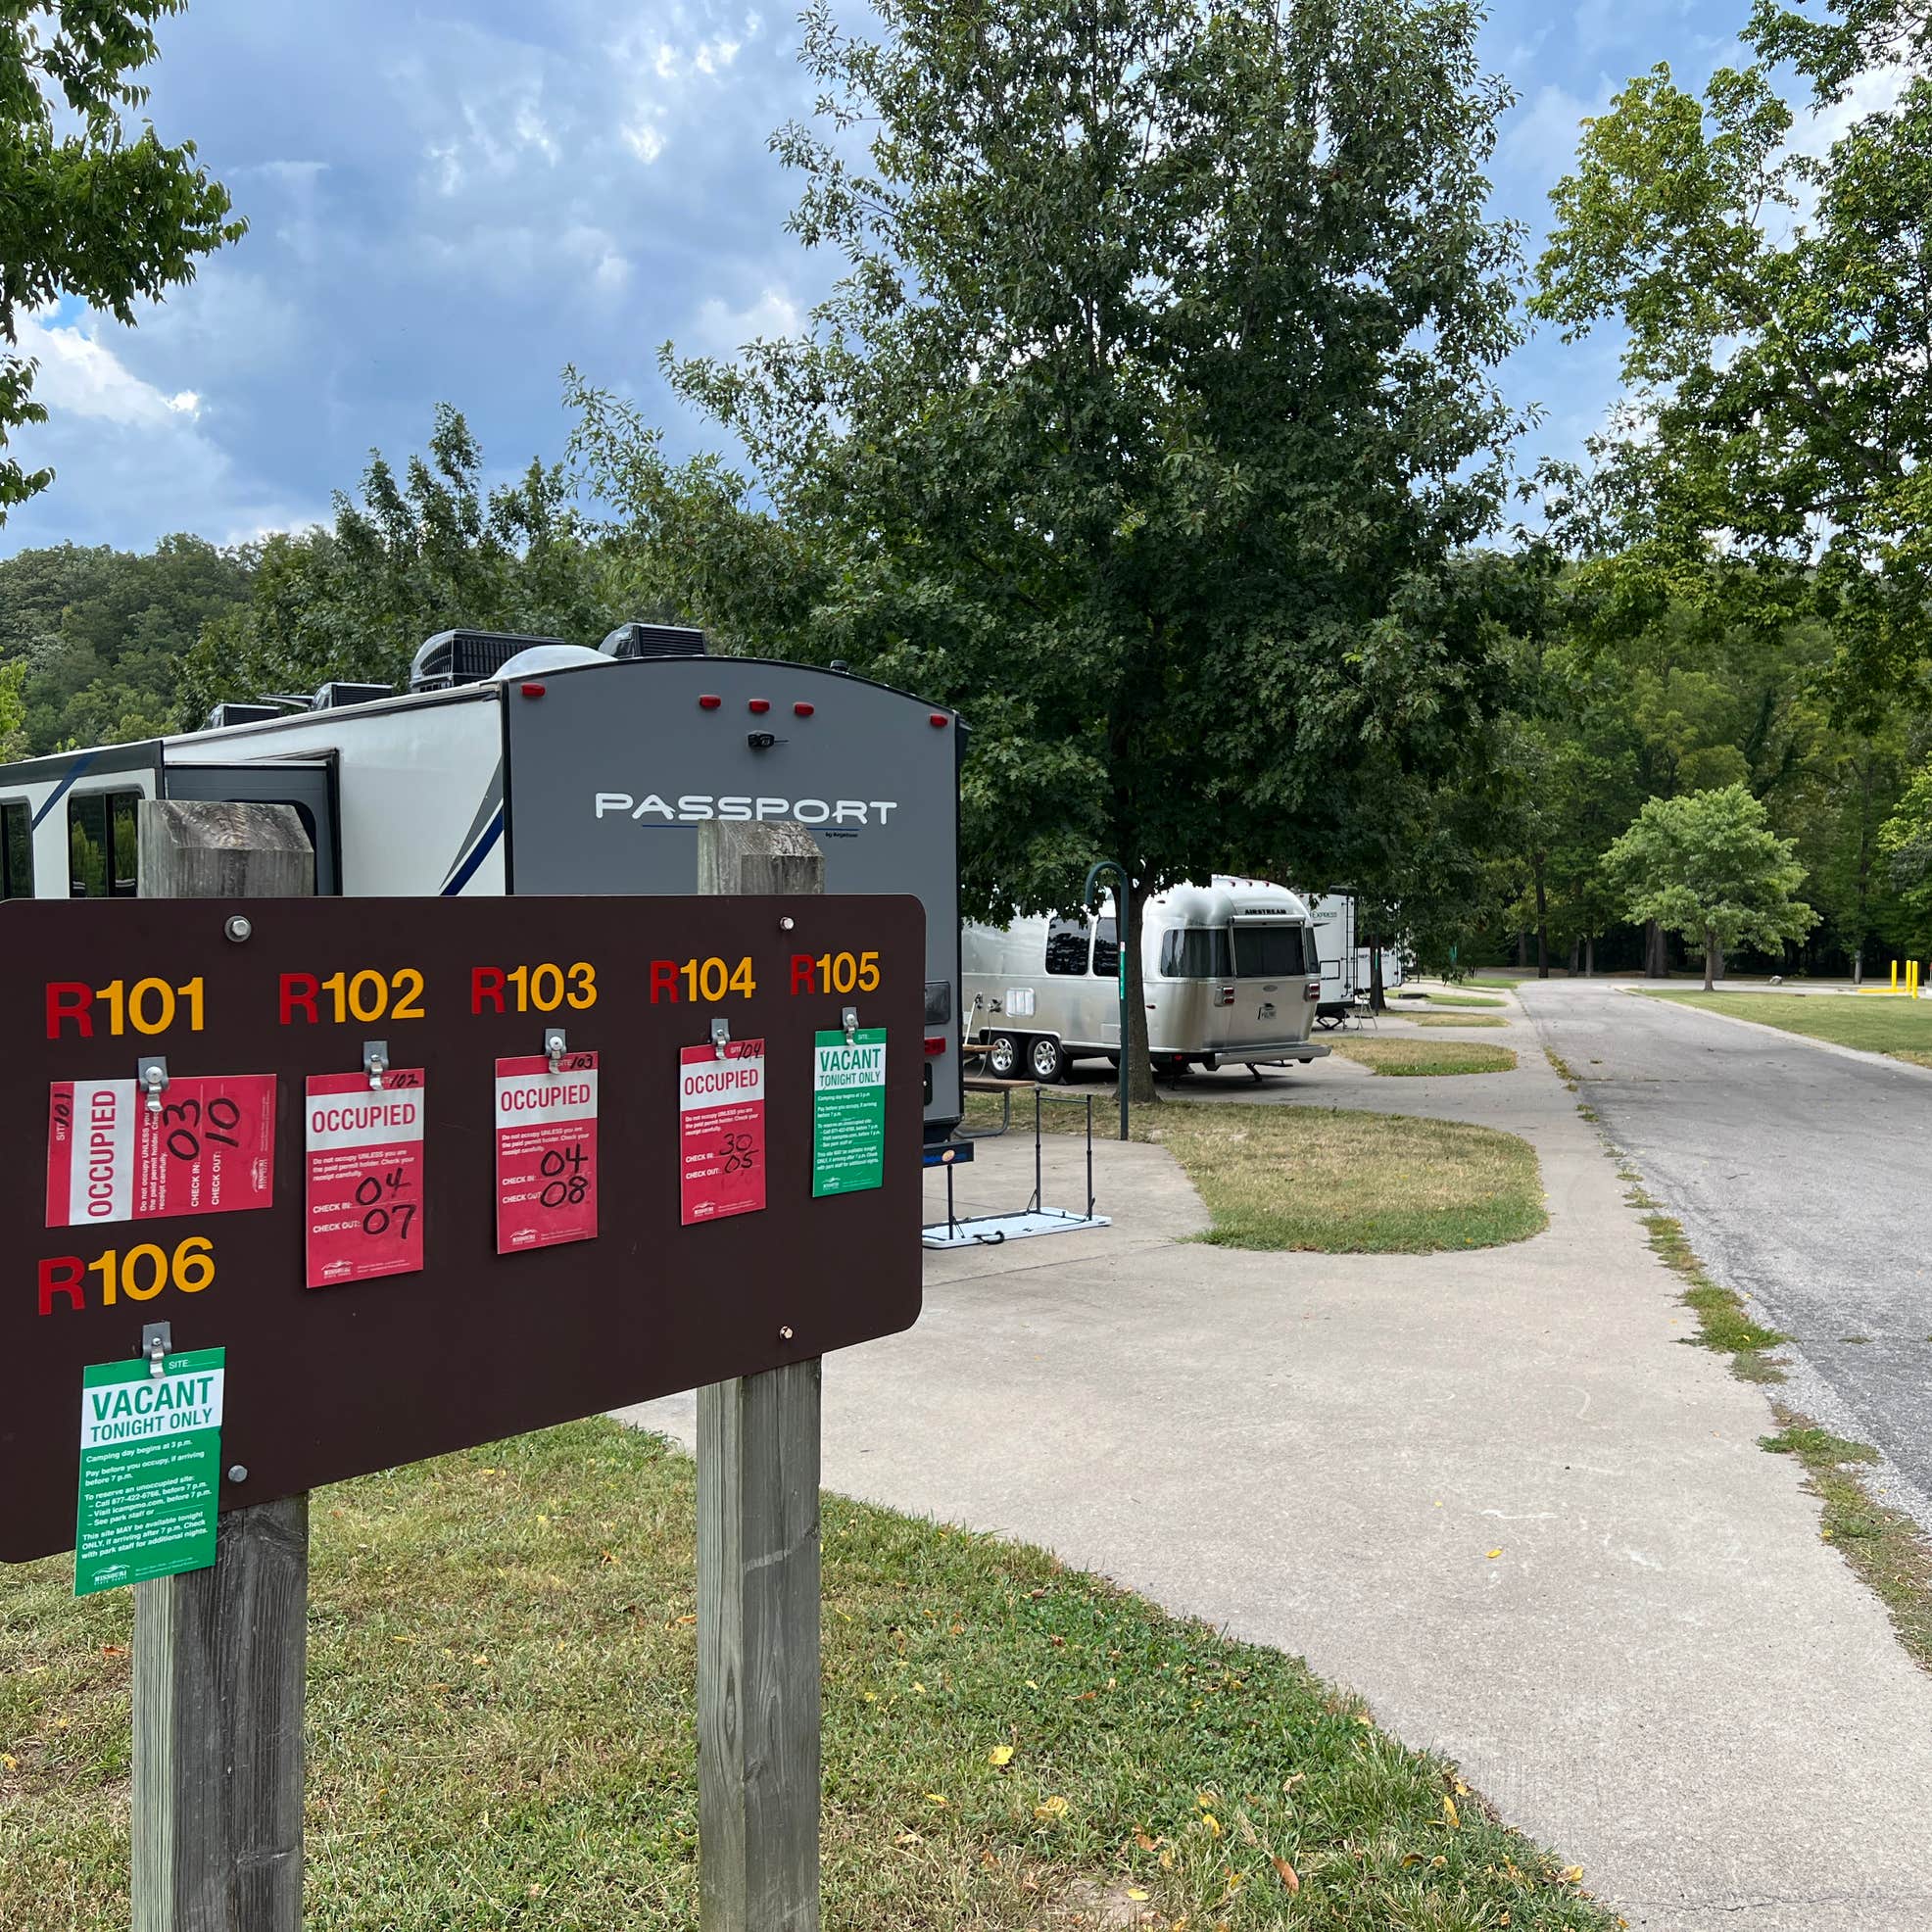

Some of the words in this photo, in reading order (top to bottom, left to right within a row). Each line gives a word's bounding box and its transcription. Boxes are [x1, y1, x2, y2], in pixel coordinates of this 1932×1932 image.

[595, 792, 897, 825] PASSPORT
[651, 957, 756, 1003] R104
[791, 952, 880, 994] R105
[280, 969, 424, 1024] R102
[472, 962, 597, 1014] R103
[47, 977, 204, 1038] R101
[570, 1054, 593, 1069] 103
[737, 1042, 762, 1061] 104
[820, 1048, 881, 1072] VACANT
[390, 1074, 419, 1087] 102
[685, 1069, 758, 1095] OCCUPIED
[819, 1073, 856, 1087] TONIGHT
[859, 1071, 880, 1084] ONLY
[54, 1093, 72, 1127] 101
[502, 1085, 590, 1111] OCCUPIED
[163, 1099, 201, 1160] 03
[205, 1098, 240, 1147] 10
[313, 1103, 415, 1133] OCCUPIED
[88, 1091, 116, 1217] OCCUPIED
[720, 1134, 752, 1155] 30
[541, 1144, 588, 1176] 04
[686, 1154, 705, 1163] CHECK
[725, 1149, 759, 1173] 05
[191, 1176, 200, 1207] CHECK
[356, 1168, 411, 1205] 04
[503, 1176, 525, 1185] CHECK
[540, 1176, 588, 1207] 08
[314, 1203, 340, 1213] CHECK
[503, 1194, 526, 1203] CHECK
[314, 1223, 340, 1232] CHECK
[363, 1204, 416, 1239] 07
[38, 1236, 215, 1315] R106
[169, 1360, 188, 1369] SITE
[93, 1377, 214, 1421] VACANT
[91, 1416, 165, 1442] TONIGHT
[170, 1408, 212, 1428] ONLY
[86, 1452, 120, 1463] Camping
[136, 1445, 161, 1454] begins
[177, 1439, 192, 1448] p.m.
[102, 1466, 125, 1474] before
[177, 1451, 205, 1461] arriving
[85, 1477, 110, 1486] before
[96, 1489, 123, 1499] reserve
[136, 1476, 178, 1490] unoccupied
[163, 1485, 185, 1495] before
[167, 1494, 189, 1503] before
[197, 1489, 212, 1498] p.m.
[110, 1515, 126, 1524] park
[128, 1511, 144, 1520] staff
[145, 1517, 176, 1528] available
[178, 1512, 203, 1521] tonight
[113, 1534, 141, 1544] arriving
[168, 1525, 182, 1534] p.m.
[184, 1520, 205, 1528] Check
[100, 1547, 116, 1557] park
[119, 1542, 134, 1551] staff
[148, 1533, 183, 1545] additional
